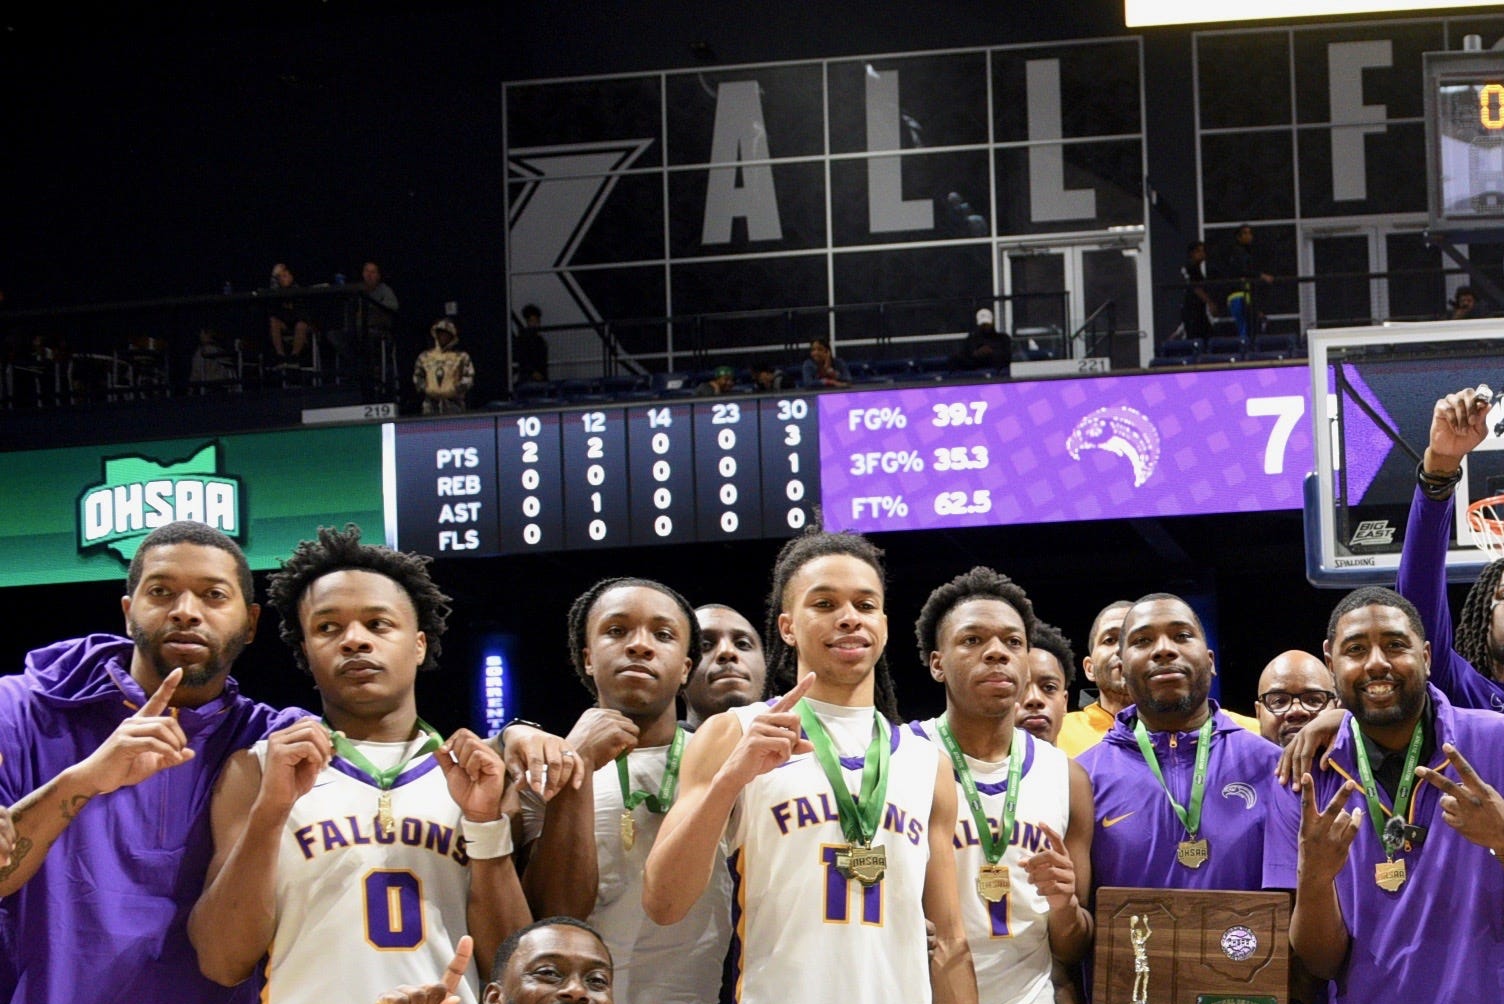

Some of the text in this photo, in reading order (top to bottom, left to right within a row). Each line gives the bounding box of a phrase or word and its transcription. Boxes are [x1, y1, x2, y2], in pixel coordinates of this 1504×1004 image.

[701, 58, 1096, 245] ALL
[365, 404, 391, 418] 219
[517, 399, 808, 437] 10 12 14 23 30
[849, 401, 988, 431] FG% 39.7
[437, 424, 801, 469] PTS 2 2 0 0 3
[850, 445, 989, 476] 3FG% 35.3
[437, 452, 799, 497] REB 0 0 0 0 1
[84, 479, 235, 540] OHSAA
[439, 479, 804, 524] AST 0 1 0 0 0
[851, 490, 992, 520] FT% 62.5
[439, 507, 805, 551] FLS 0 0 0 0 0
[1355, 529, 1392, 539] EAST
[1360, 522, 1385, 531] BIG
[1335, 557, 1375, 568] SPALDING
[294, 815, 471, 867] FALCONS
[770, 793, 923, 846] FALNS
[819, 843, 885, 928] 11
[361, 867, 427, 953] 0
